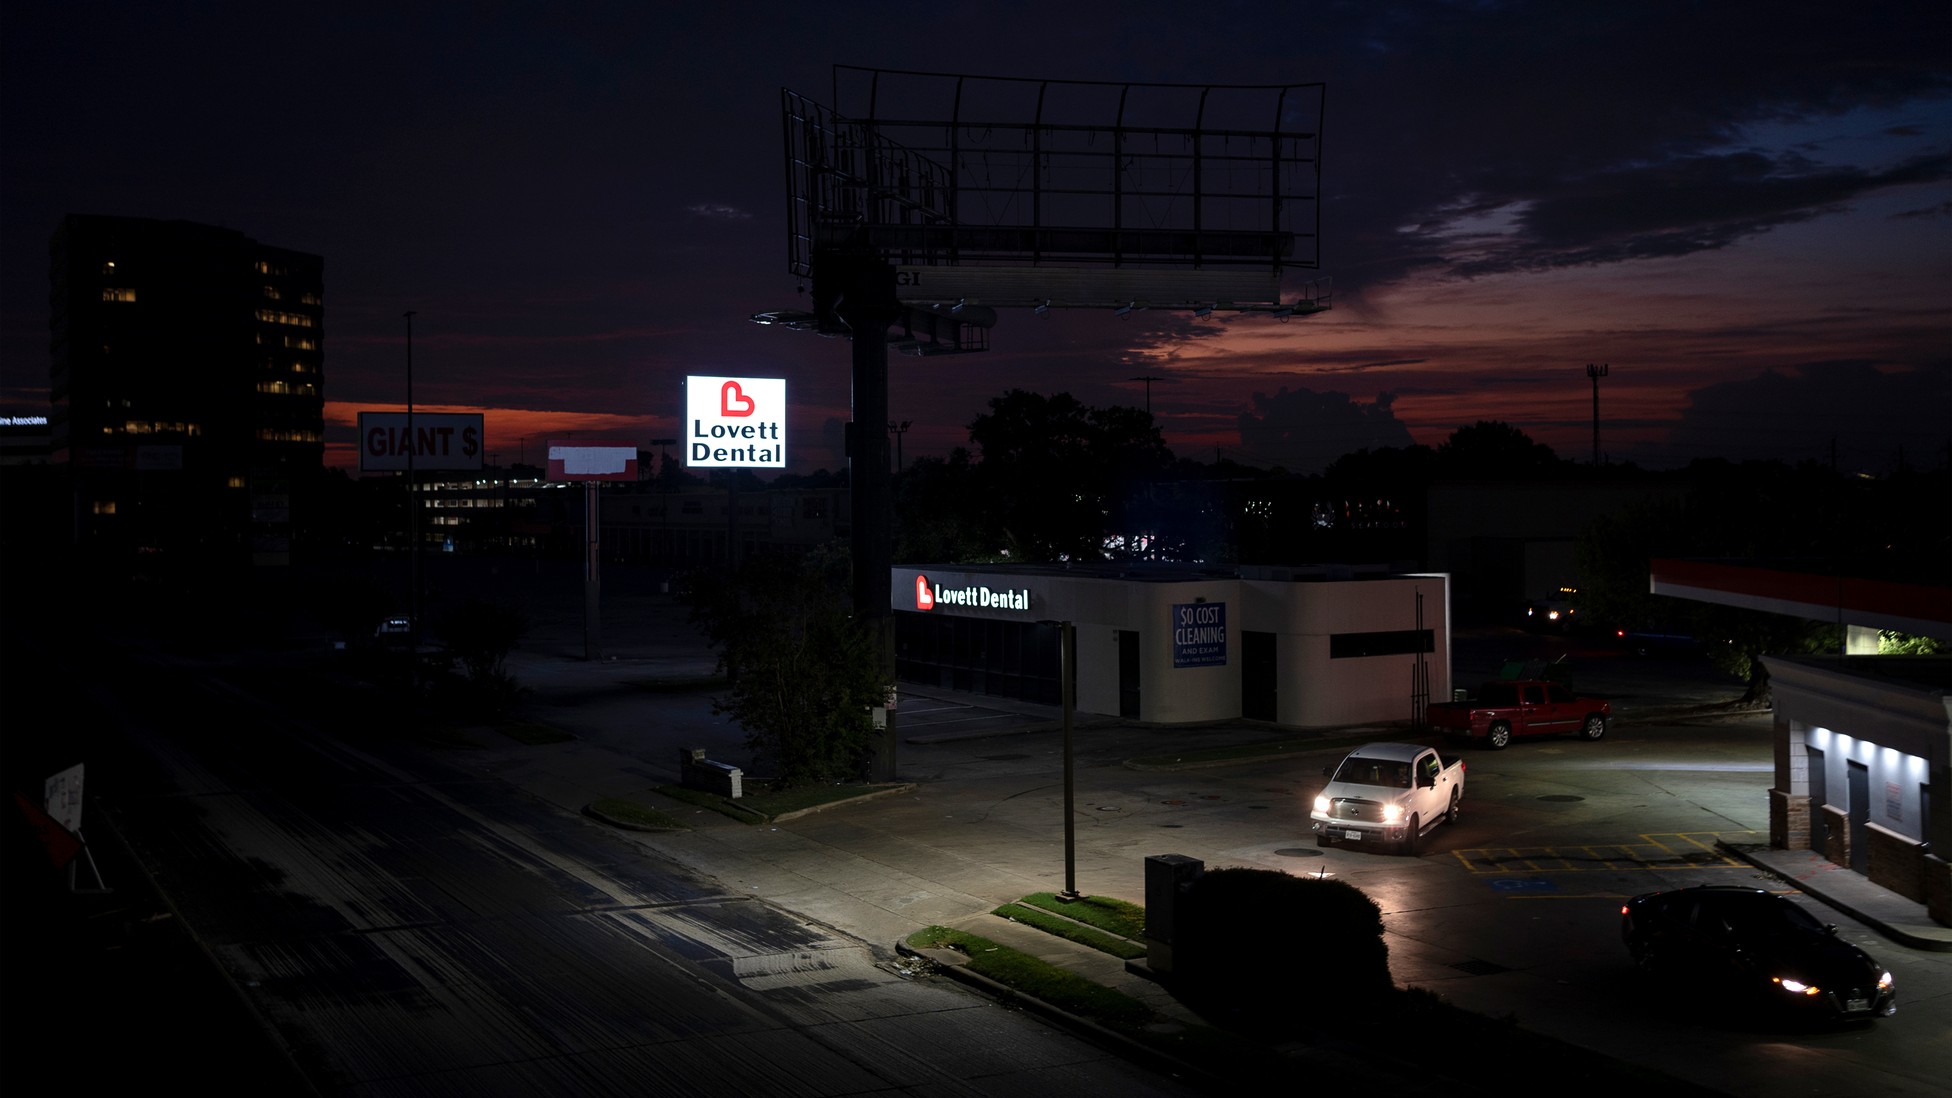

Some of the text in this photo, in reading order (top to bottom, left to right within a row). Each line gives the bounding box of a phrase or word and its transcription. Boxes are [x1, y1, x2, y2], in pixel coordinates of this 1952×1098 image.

[12, 416, 47, 425] Associates
[694, 419, 779, 440] Lovett
[368, 427, 454, 457] GIANT
[692, 442, 781, 463] Dental
[935, 583, 1028, 610] Lovett Dental
[1180, 606, 1220, 627] $0 COST
[1175, 626, 1225, 646] CLEANING
[1199, 646, 1219, 654] EXAM
